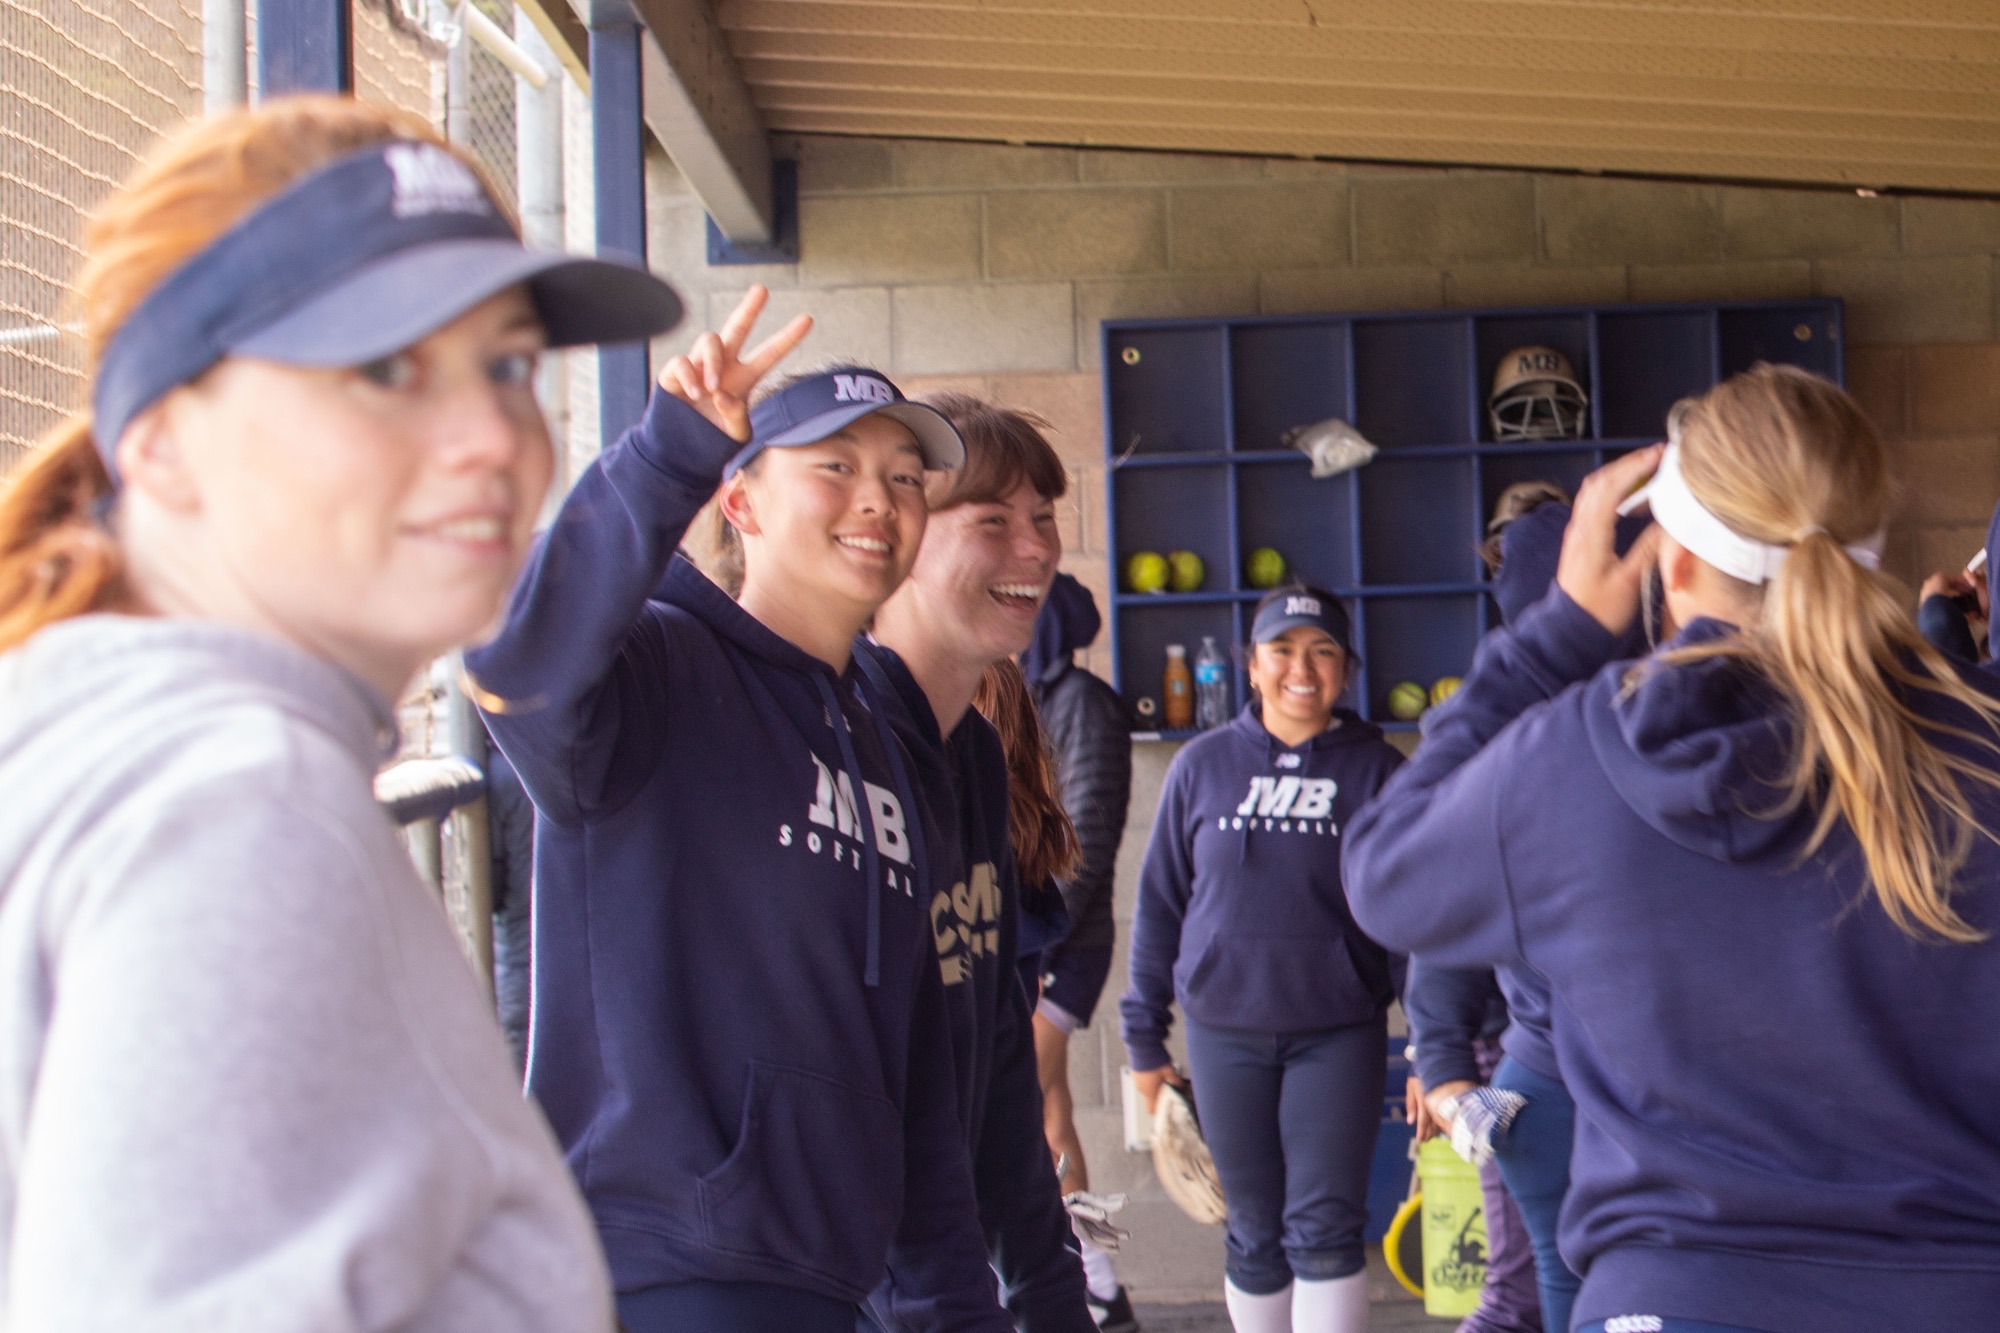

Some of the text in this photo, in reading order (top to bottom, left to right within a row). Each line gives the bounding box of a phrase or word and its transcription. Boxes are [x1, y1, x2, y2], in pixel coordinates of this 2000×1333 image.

[833, 374, 894, 403] MB
[808, 749, 911, 866] MB
[1236, 774, 1338, 819] MB
[778, 823, 914, 899] SOFTAL
